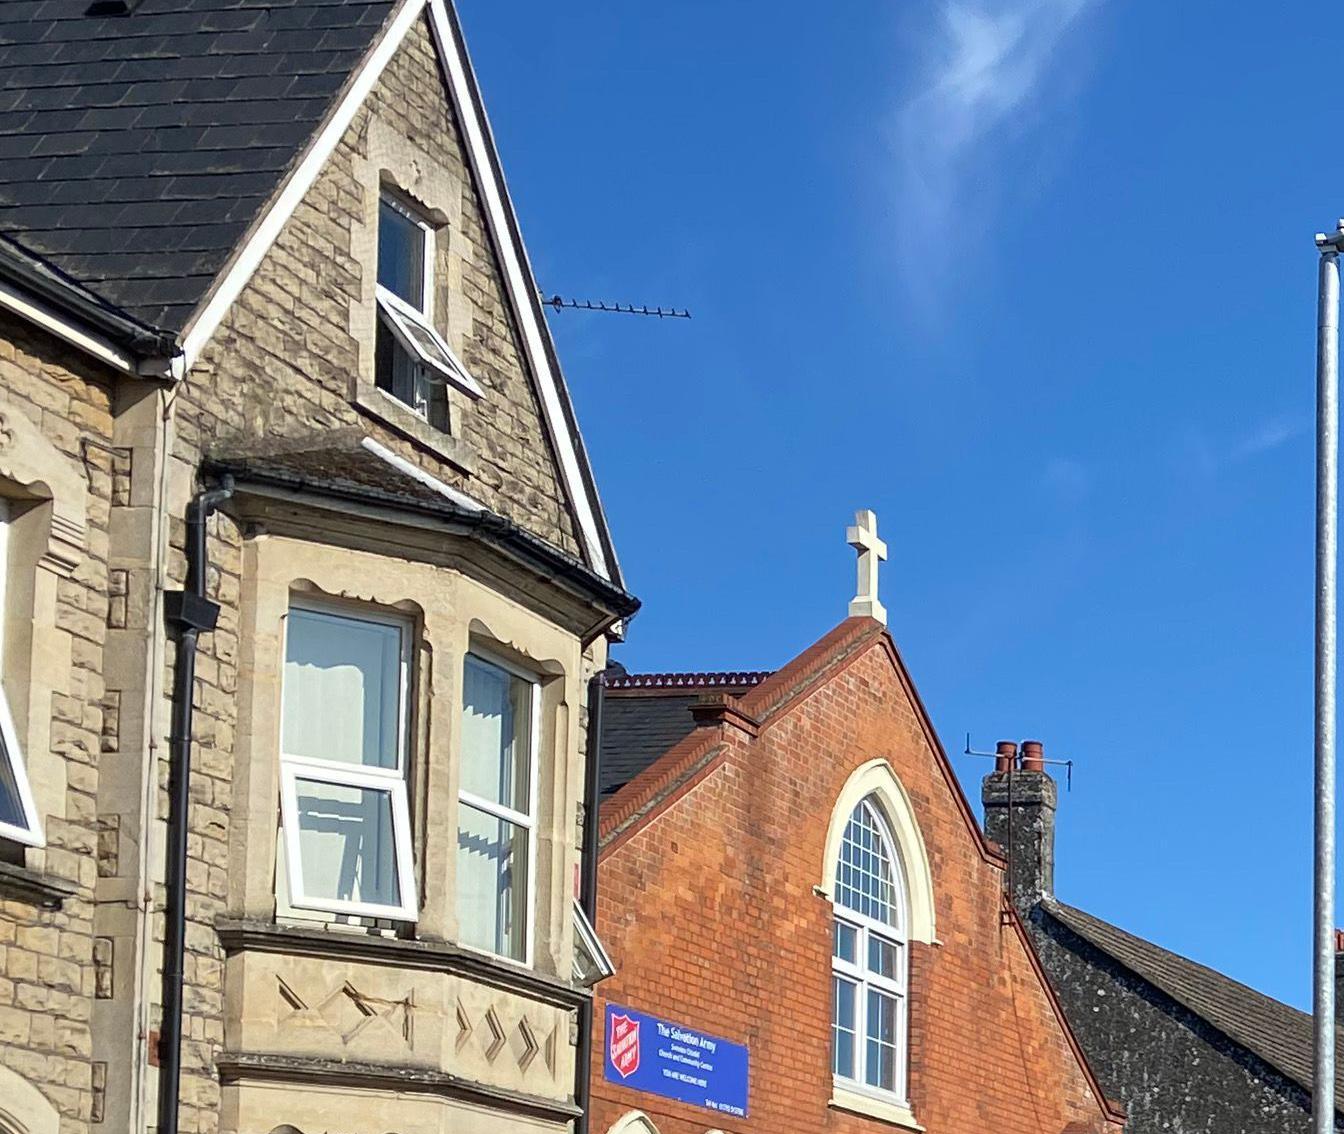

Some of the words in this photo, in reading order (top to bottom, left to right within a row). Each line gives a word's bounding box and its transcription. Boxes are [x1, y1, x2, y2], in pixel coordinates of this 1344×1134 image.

[657, 1022, 670, 1038] The
[670, 1027, 700, 1047] Salvation
[700, 1037, 717, 1054] Army
